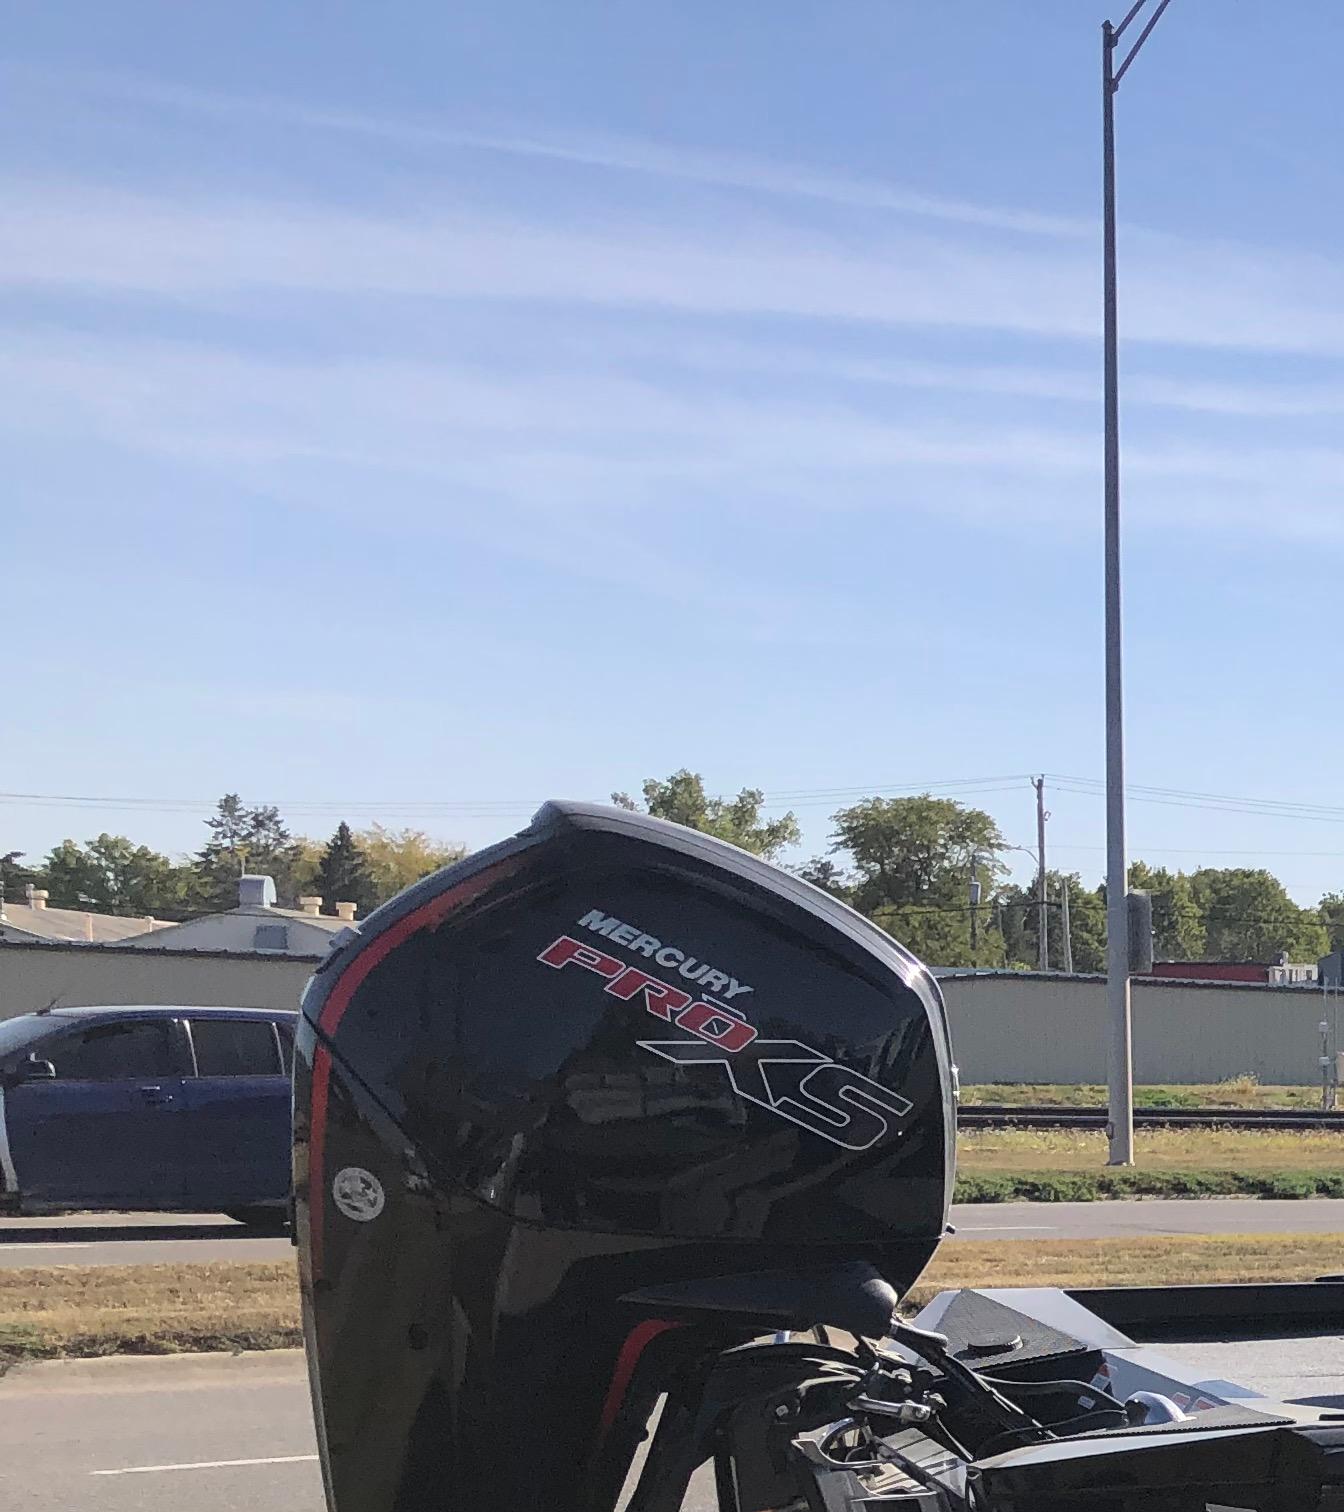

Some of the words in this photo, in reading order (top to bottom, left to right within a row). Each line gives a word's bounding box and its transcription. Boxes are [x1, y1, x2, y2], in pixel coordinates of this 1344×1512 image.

[536, 935, 758, 1052] PRO
[576, 909, 755, 999] MERCURY
[635, 1039, 914, 1150] XS
